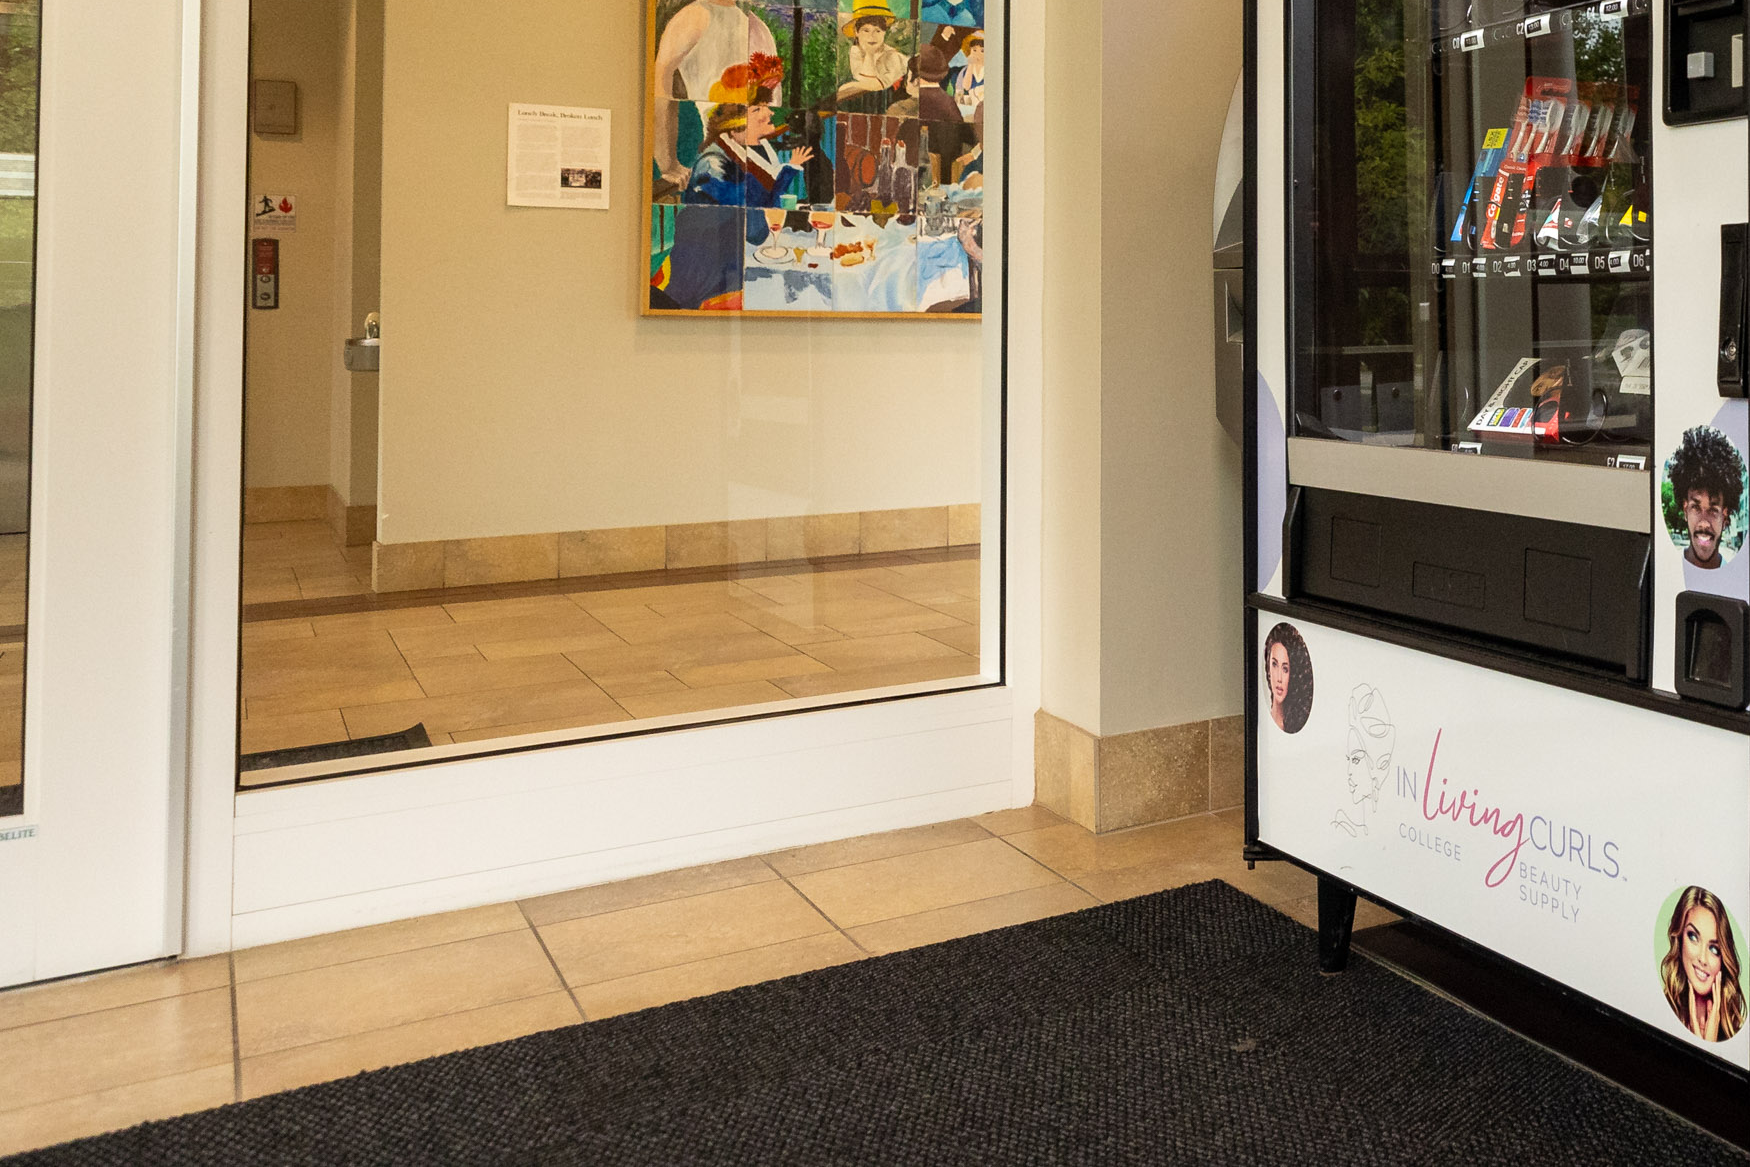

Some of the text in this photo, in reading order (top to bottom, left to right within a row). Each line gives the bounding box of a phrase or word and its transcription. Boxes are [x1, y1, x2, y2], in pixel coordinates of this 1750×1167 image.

[1487, 174, 1505, 218] Colgate
[1514, 360, 1529, 375] CAP
[1396, 764, 1417, 804] IN
[1423, 727, 1530, 889] living
[1399, 822, 1462, 862] COLLEGE
[1519, 860, 1583, 902] BEAUTY
[1519, 884, 1581, 924] SUPPLY
